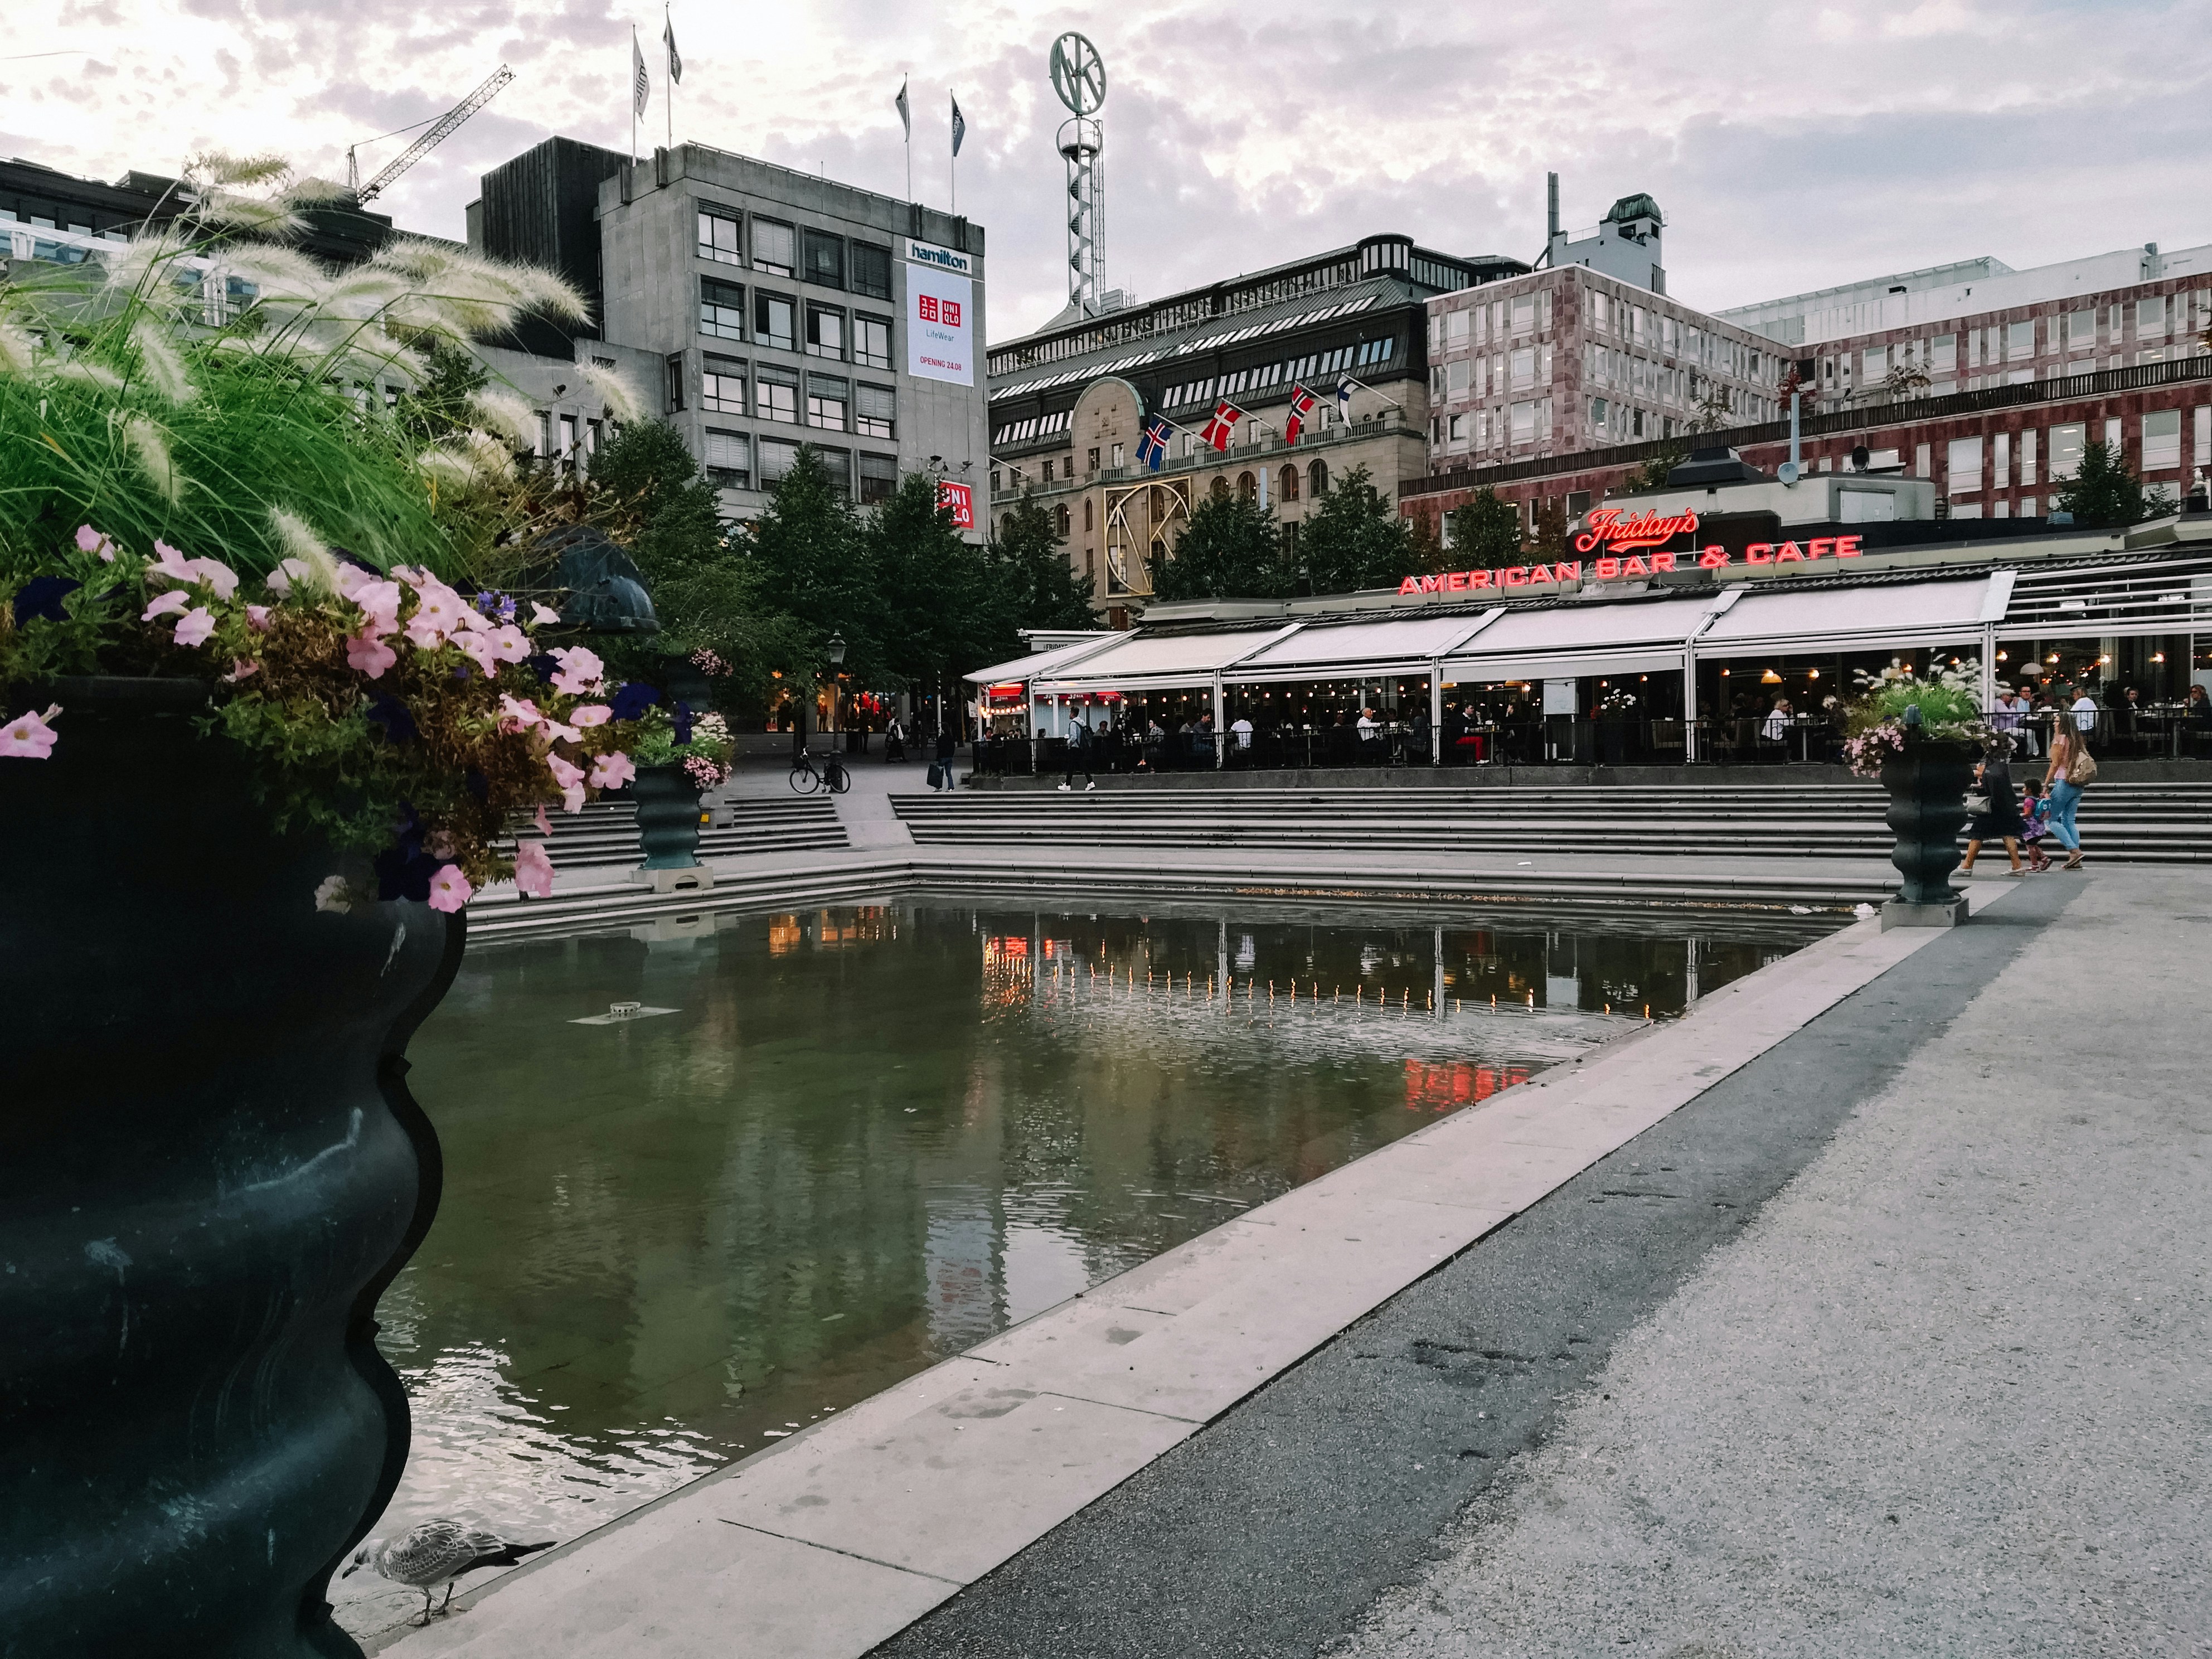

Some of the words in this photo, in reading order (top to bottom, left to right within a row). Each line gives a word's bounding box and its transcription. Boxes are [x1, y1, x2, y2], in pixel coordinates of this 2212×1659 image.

[912, 242, 967, 270] hamilton
[944, 303, 958, 314] UNI
[944, 313, 959, 324] QLO
[926, 329, 954, 341] LifeWear
[920, 356, 945, 367] OPENING
[947, 361, 962, 371] 24.08
[1575, 507, 1699, 553] Friday's
[1398, 560, 1582, 595] AMERICAN
[1597, 551, 1679, 580] BAR
[1699, 545, 1733, 570] &
[1747, 535, 1863, 565] CAFE
